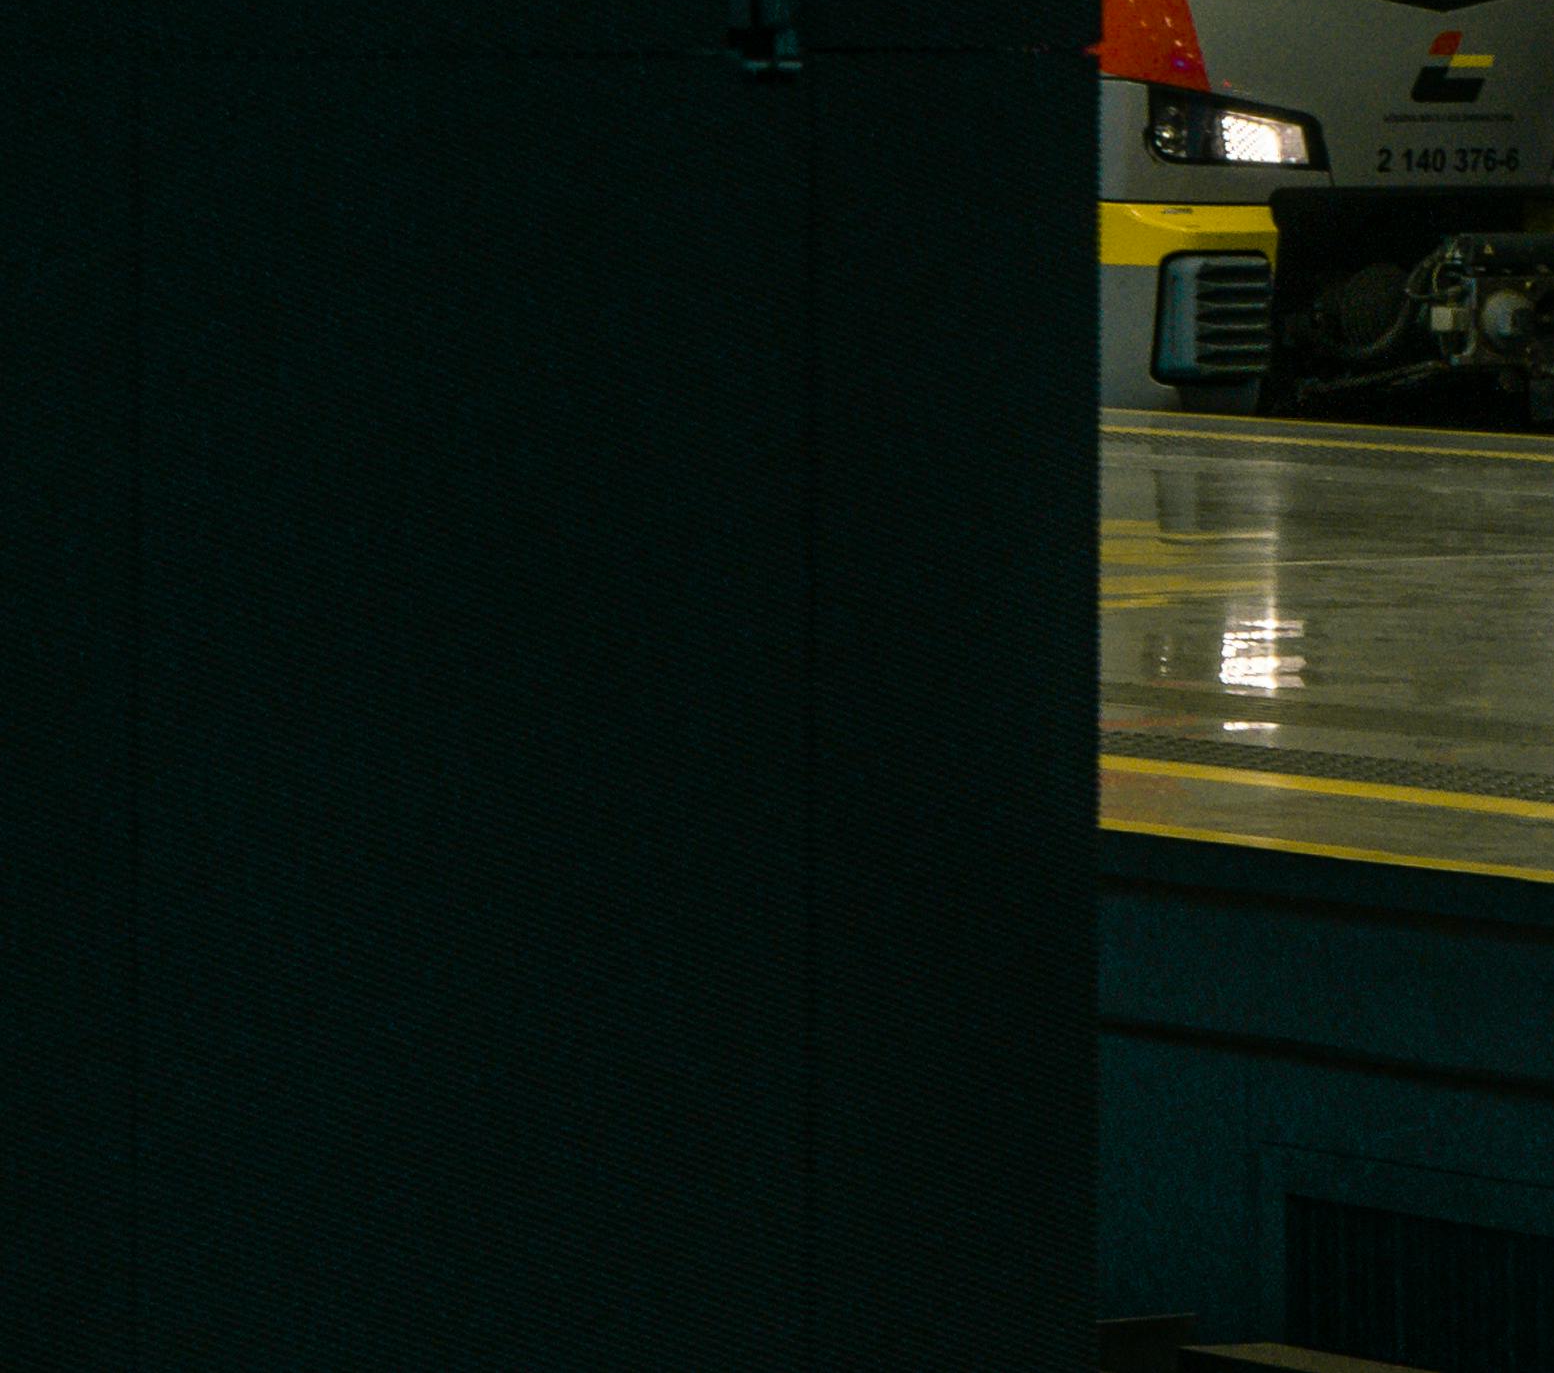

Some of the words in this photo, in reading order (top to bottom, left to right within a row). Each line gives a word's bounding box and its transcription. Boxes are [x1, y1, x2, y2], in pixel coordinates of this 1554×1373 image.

[1377, 148, 1392, 173] 2
[1402, 148, 1446, 173] 140
[1454, 148, 1519, 173] 376-6
